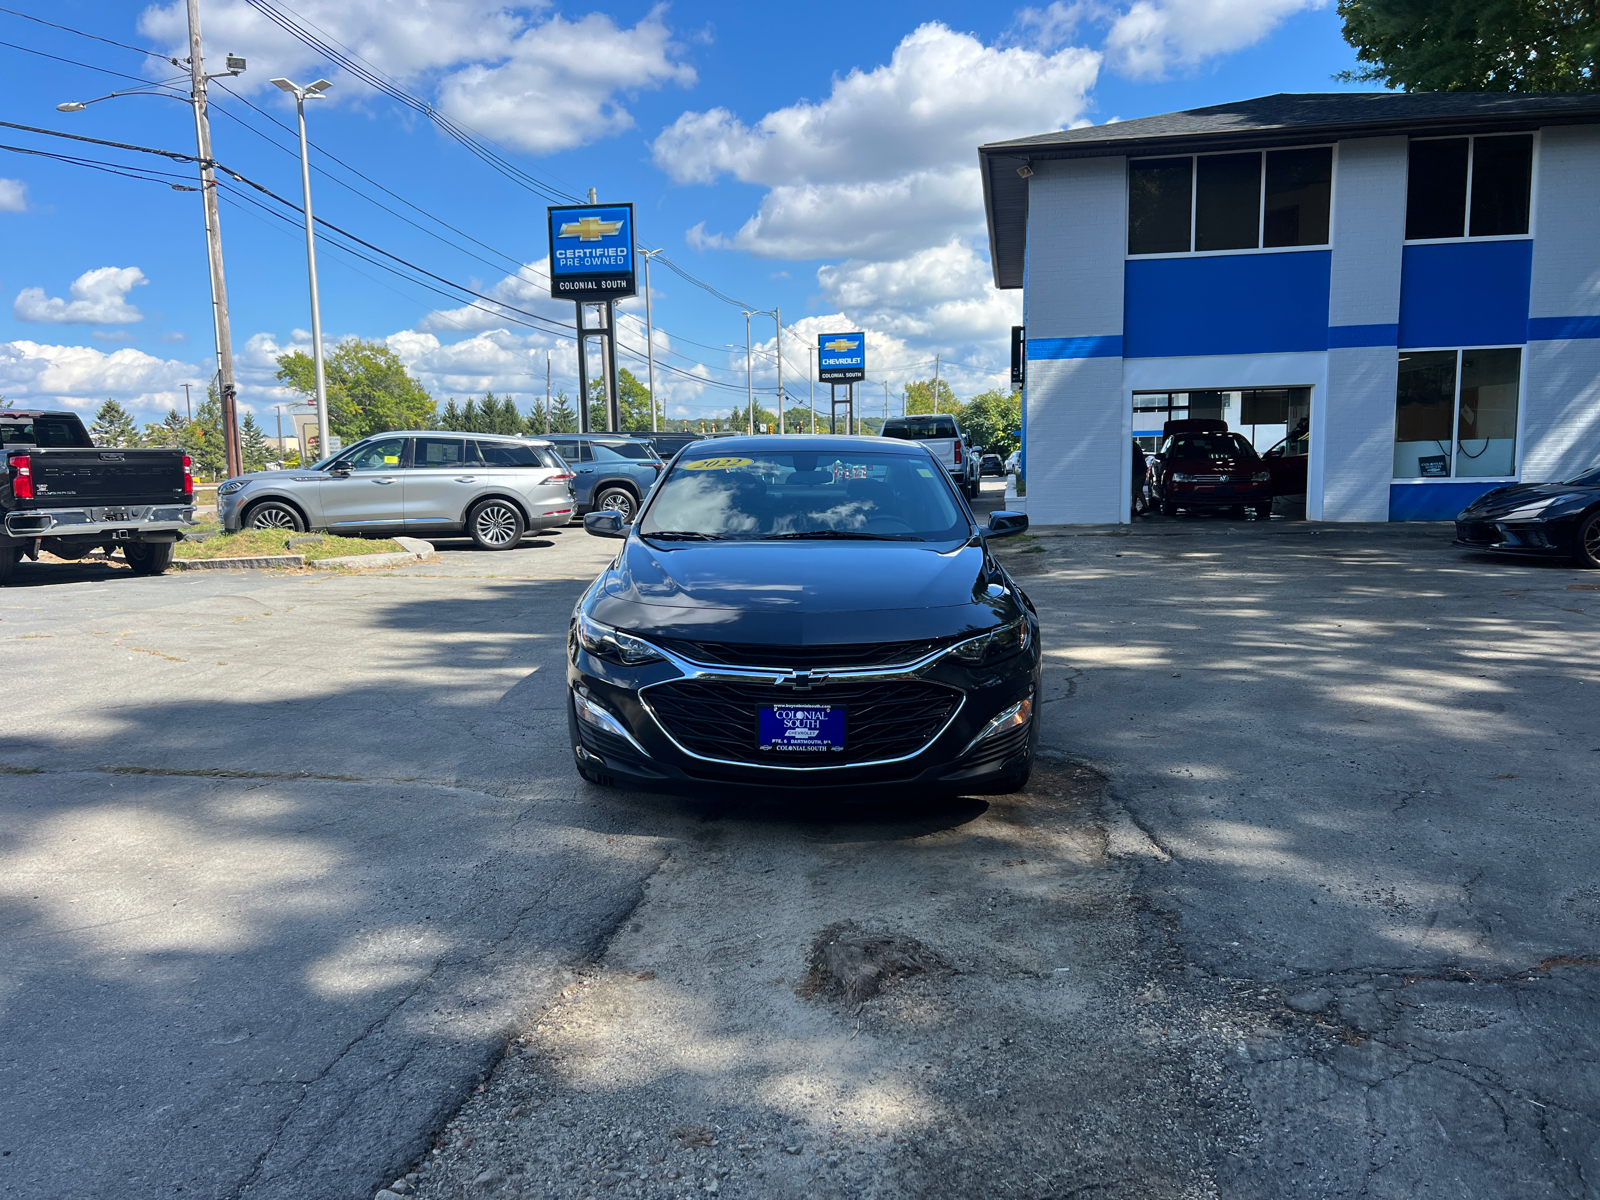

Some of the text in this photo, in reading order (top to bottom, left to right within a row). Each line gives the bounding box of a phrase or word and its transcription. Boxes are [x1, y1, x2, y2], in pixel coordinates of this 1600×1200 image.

[556, 247, 627, 258] CERTIFIED
[560, 256, 624, 266] PRE-OWNED
[559, 279, 627, 290] COLONIAL SOUTH
[822, 357, 861, 365] CHEVROLET
[694, 459, 742, 468] 2022
[44, 467, 175, 476] CHEVROLET
[776, 710, 829, 720] COLONIAL
[783, 719, 820, 728] SOUTH
